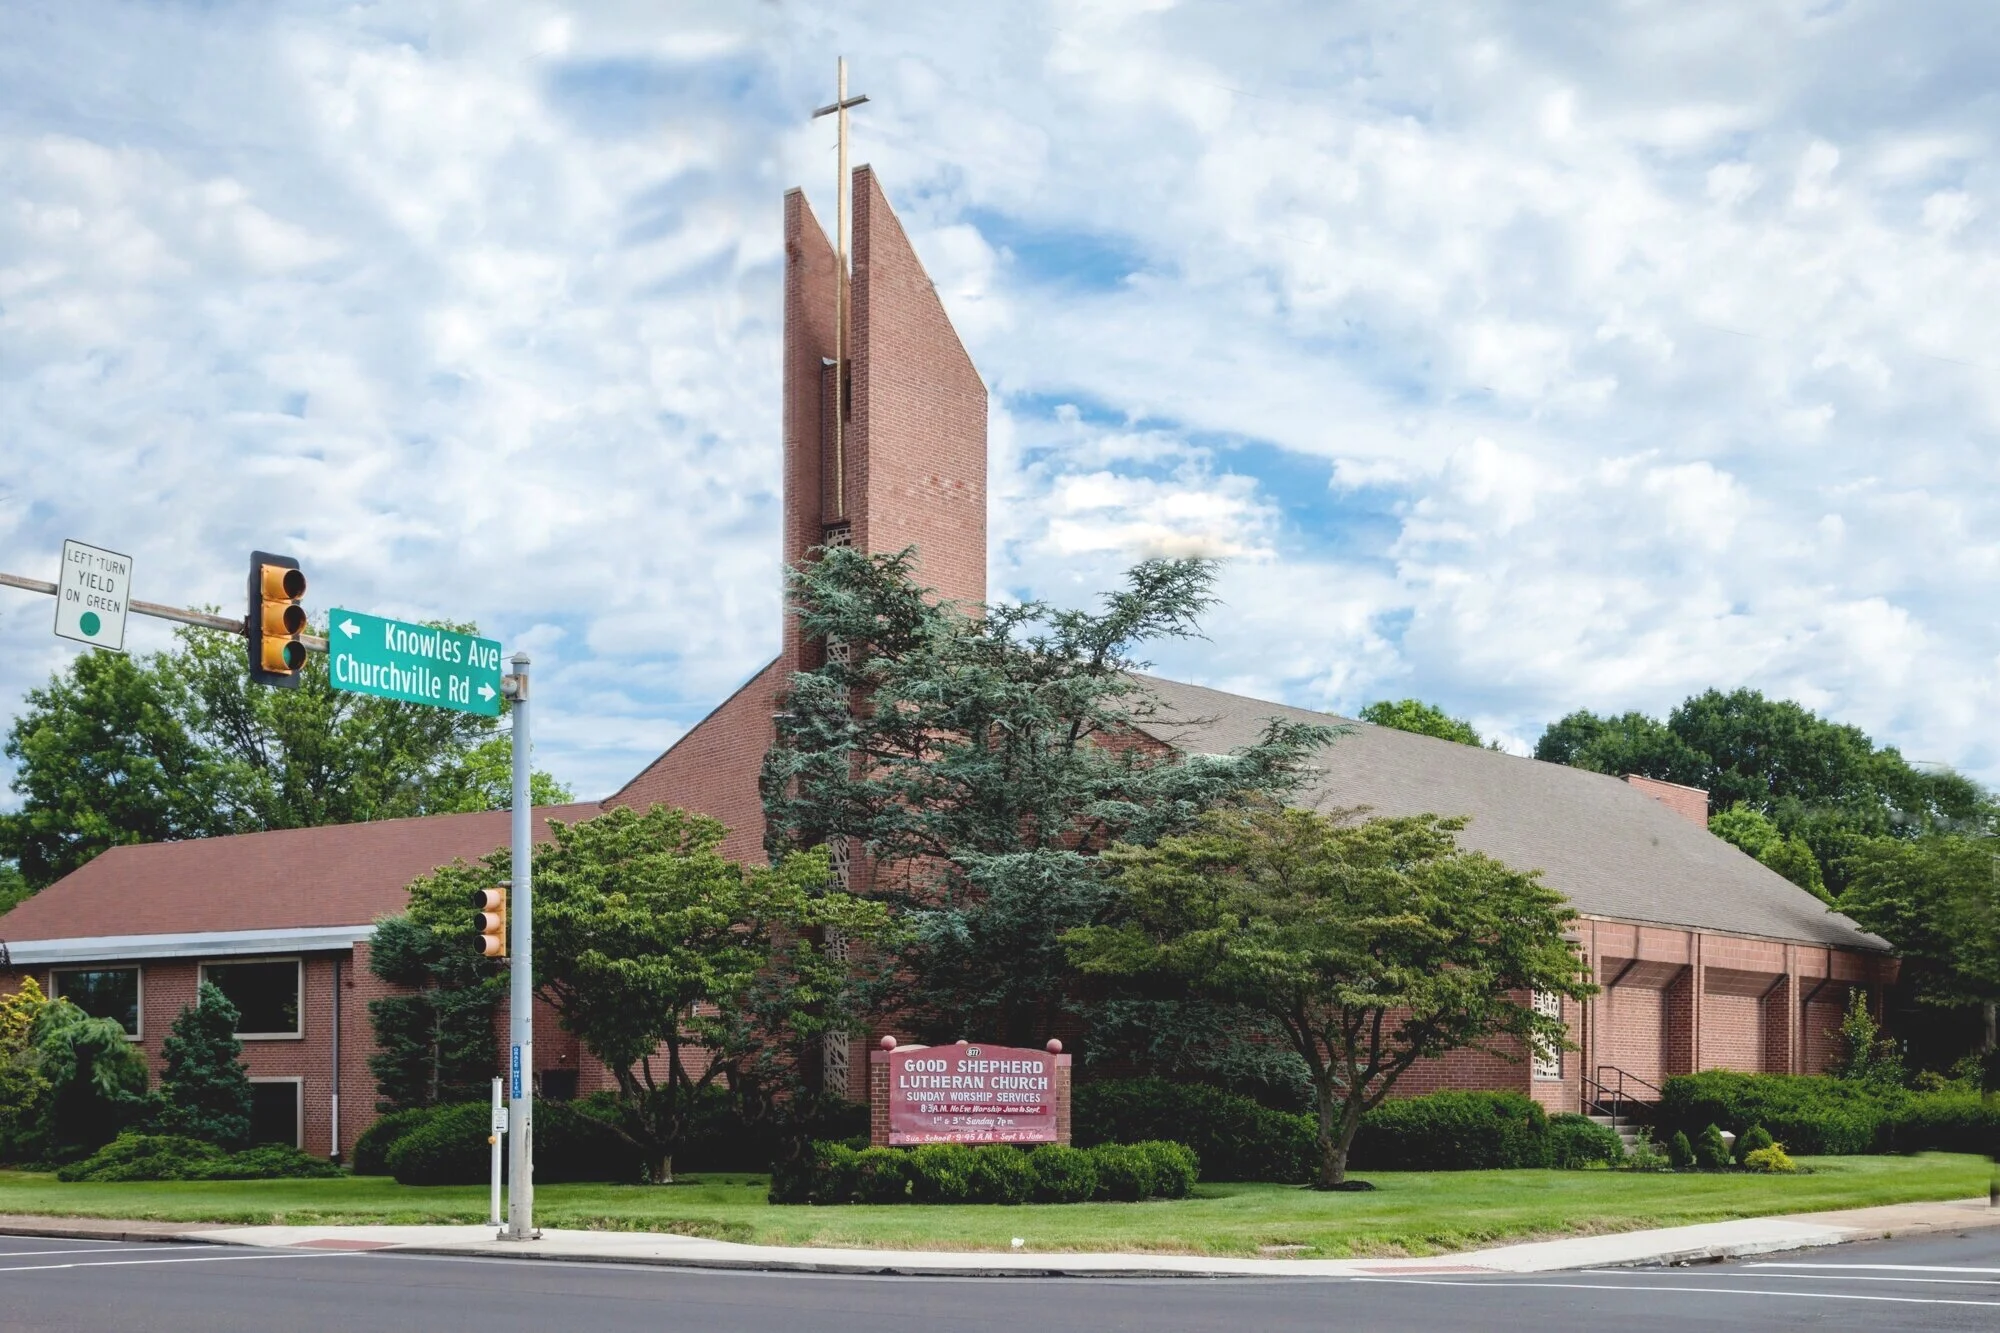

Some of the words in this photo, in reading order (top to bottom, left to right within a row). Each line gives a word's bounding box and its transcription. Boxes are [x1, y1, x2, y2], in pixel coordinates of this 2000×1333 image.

[67, 548, 93, 566] LEFT
[100, 557, 126, 576] TURN
[78, 570, 114, 593] YIELD
[66, 588, 80, 603] ON
[86, 594, 120, 614] GREEN
[385, 622, 462, 664] Knowles
[468, 640, 499, 671] Ave
[336, 653, 442, 699] Churchville
[448, 674, 470, 704] Rd
[904, 1059, 948, 1072] GOOD
[957, 1060, 1044, 1074] SHEPHERD
[900, 1075, 984, 1089] LUTHERAN
[990, 1076, 1048, 1090] CHURCH
[906, 1092, 945, 1101] SUNDAY
[950, 1092, 993, 1102] WORSHIP
[996, 1092, 1041, 1102] SERVICES
[972, 1105, 1002, 1114] Worship
[966, 1116, 994, 1128] Sunday
[924, 1134, 952, 1142] School
[1026, 1132, 1044, 1140] June
